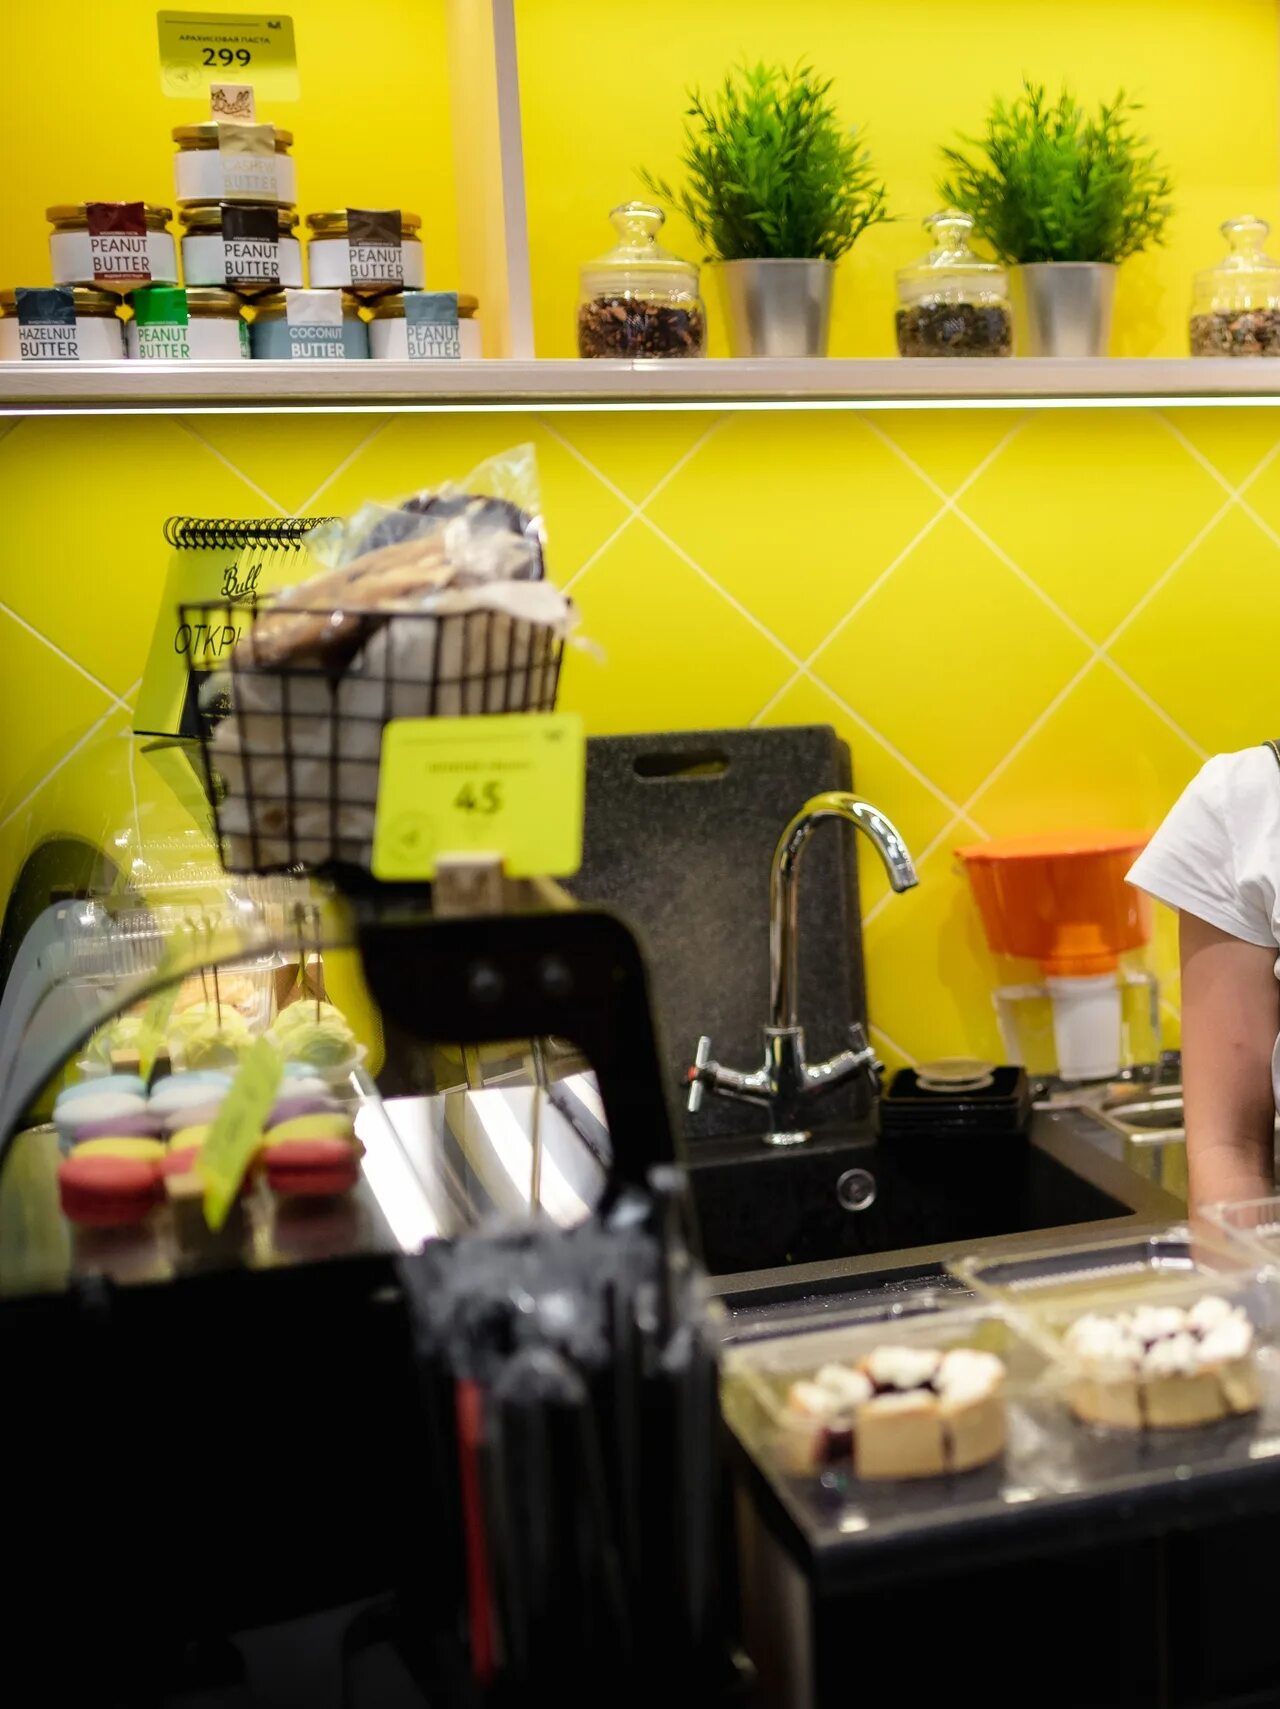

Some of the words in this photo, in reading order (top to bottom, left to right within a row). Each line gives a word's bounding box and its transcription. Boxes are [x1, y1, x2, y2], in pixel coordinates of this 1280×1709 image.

[202, 47, 252, 67] 299
[224, 175, 278, 189] BUTTER
[91, 238, 147, 252] PEANUT
[224, 243, 278, 259] PEANUT
[349, 248, 402, 263] PEANUT
[93, 256, 150, 271] BUTTER
[225, 260, 279, 276] BUTTER
[350, 264, 404, 278] BUTTER
[18, 327, 76, 340] HAZELNUT
[138, 327, 188, 342] PEANUT
[289, 327, 343, 340] COCONUT
[407, 326, 459, 341] PEANUT
[20, 341, 79, 357] BUTTER
[140, 344, 190, 359] BUTTER
[291, 342, 345, 358] BUTTER
[408, 341, 461, 357] BUTTER
[221, 562, 262, 598] Bull
[453, 780, 504, 816] 45
